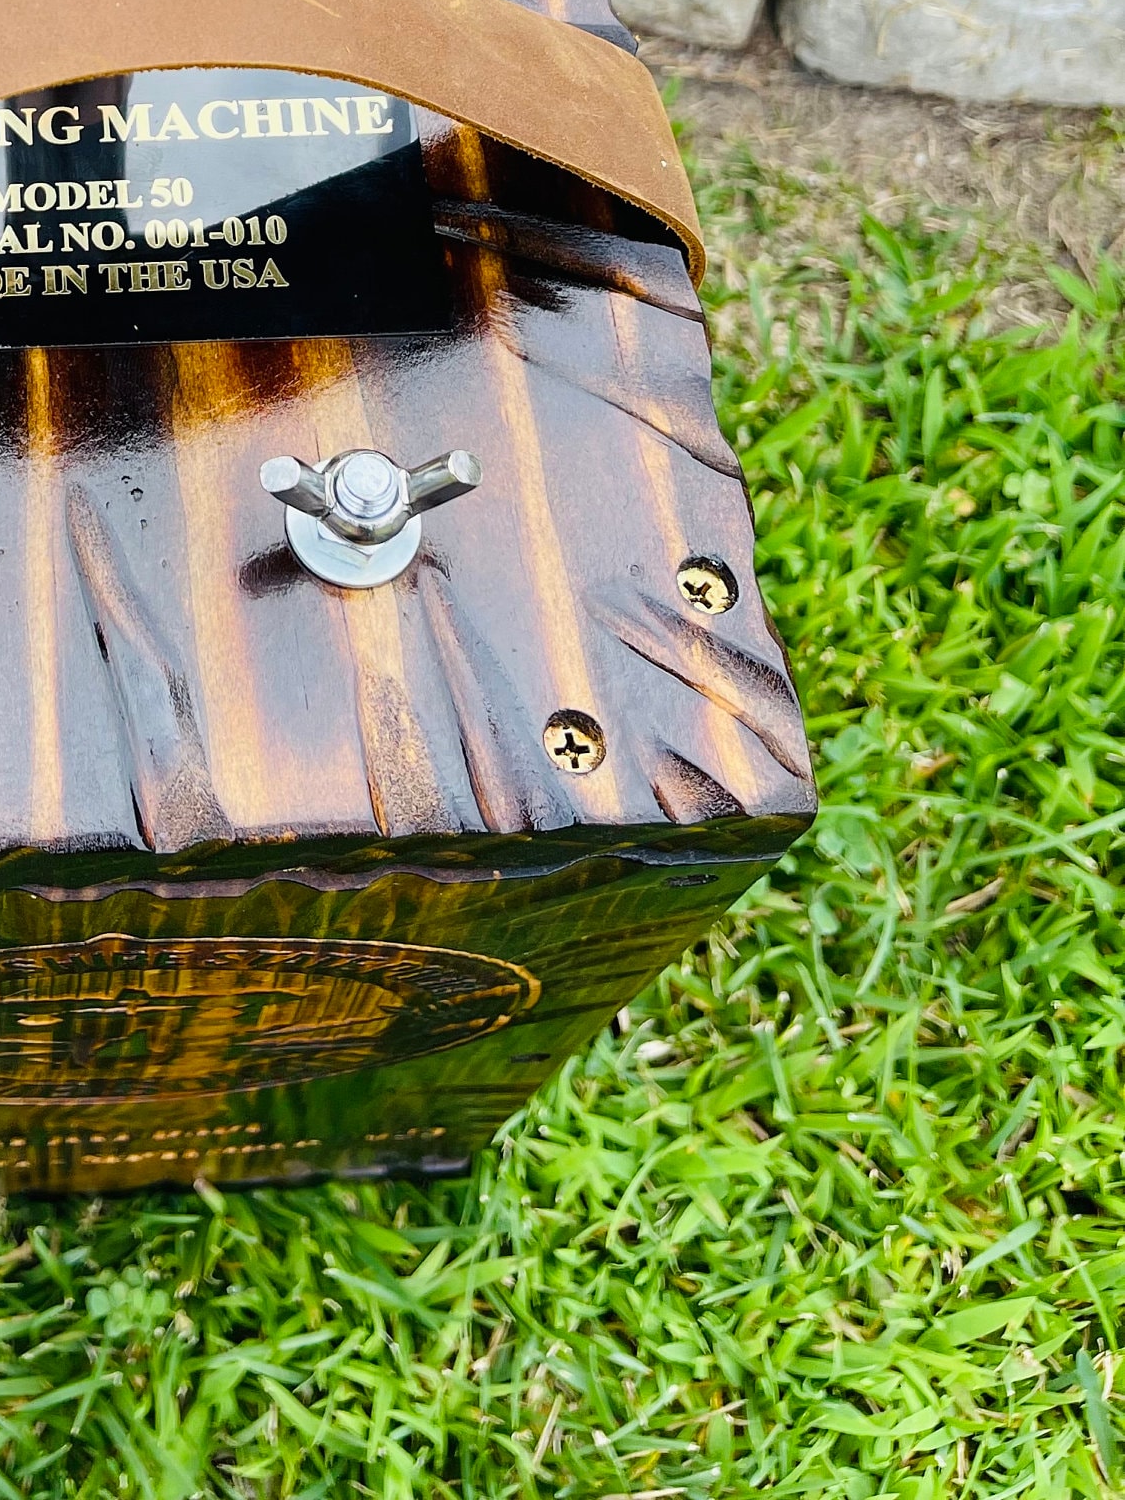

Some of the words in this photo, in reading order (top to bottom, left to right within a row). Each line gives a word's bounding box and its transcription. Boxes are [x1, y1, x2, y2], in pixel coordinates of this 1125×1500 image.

[96, 95, 394, 143] MACHINE
[150, 177, 193, 207] 50
[60, 221, 136, 252] NO.
[144, 214, 288, 248] 001-010
[41, 263, 90, 295] IN
[99, 260, 192, 293] THE
[201, 257, 290, 290] USA
